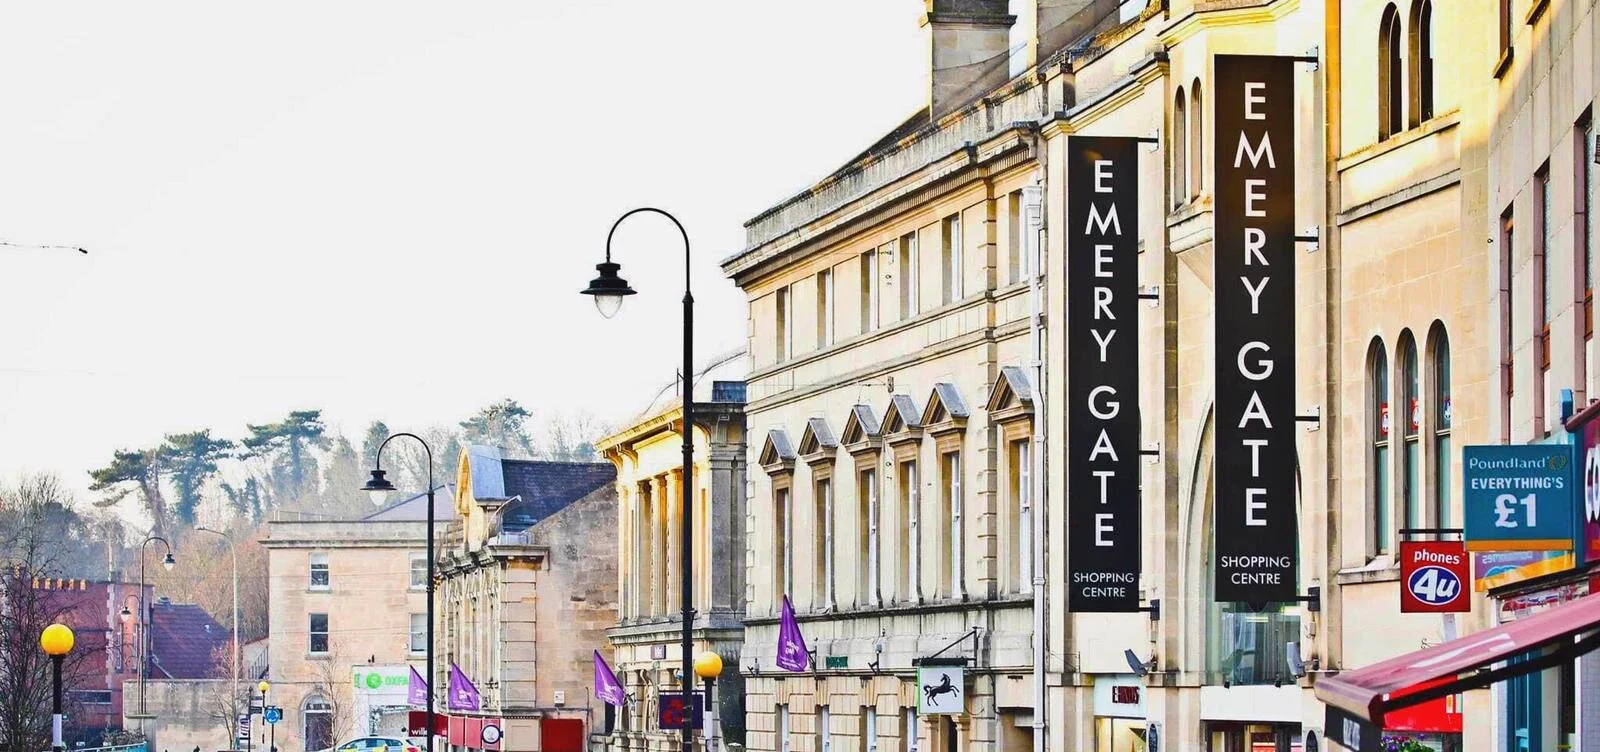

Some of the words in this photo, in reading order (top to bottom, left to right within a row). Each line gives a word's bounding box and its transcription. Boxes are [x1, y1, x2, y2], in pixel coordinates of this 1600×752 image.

[1234, 82, 1275, 314] EMERY
[1085, 159, 1122, 362] EMERY
[1237, 341, 1274, 526] GATE
[1087, 385, 1120, 547] GATE
[1469, 457, 1546, 470] Poundland
[1471, 476, 1564, 490] EVERYTHING'S
[1494, 493, 1537, 528] £1
[1221, 555, 1292, 568] SHOPPING
[1413, 548, 1460, 565] phones
[1073, 572, 1135, 583] SHOPPING
[1231, 572, 1281, 585] CENTRE
[1413, 568, 1457, 602] 4u
[1082, 586, 1126, 598] CENTRE
